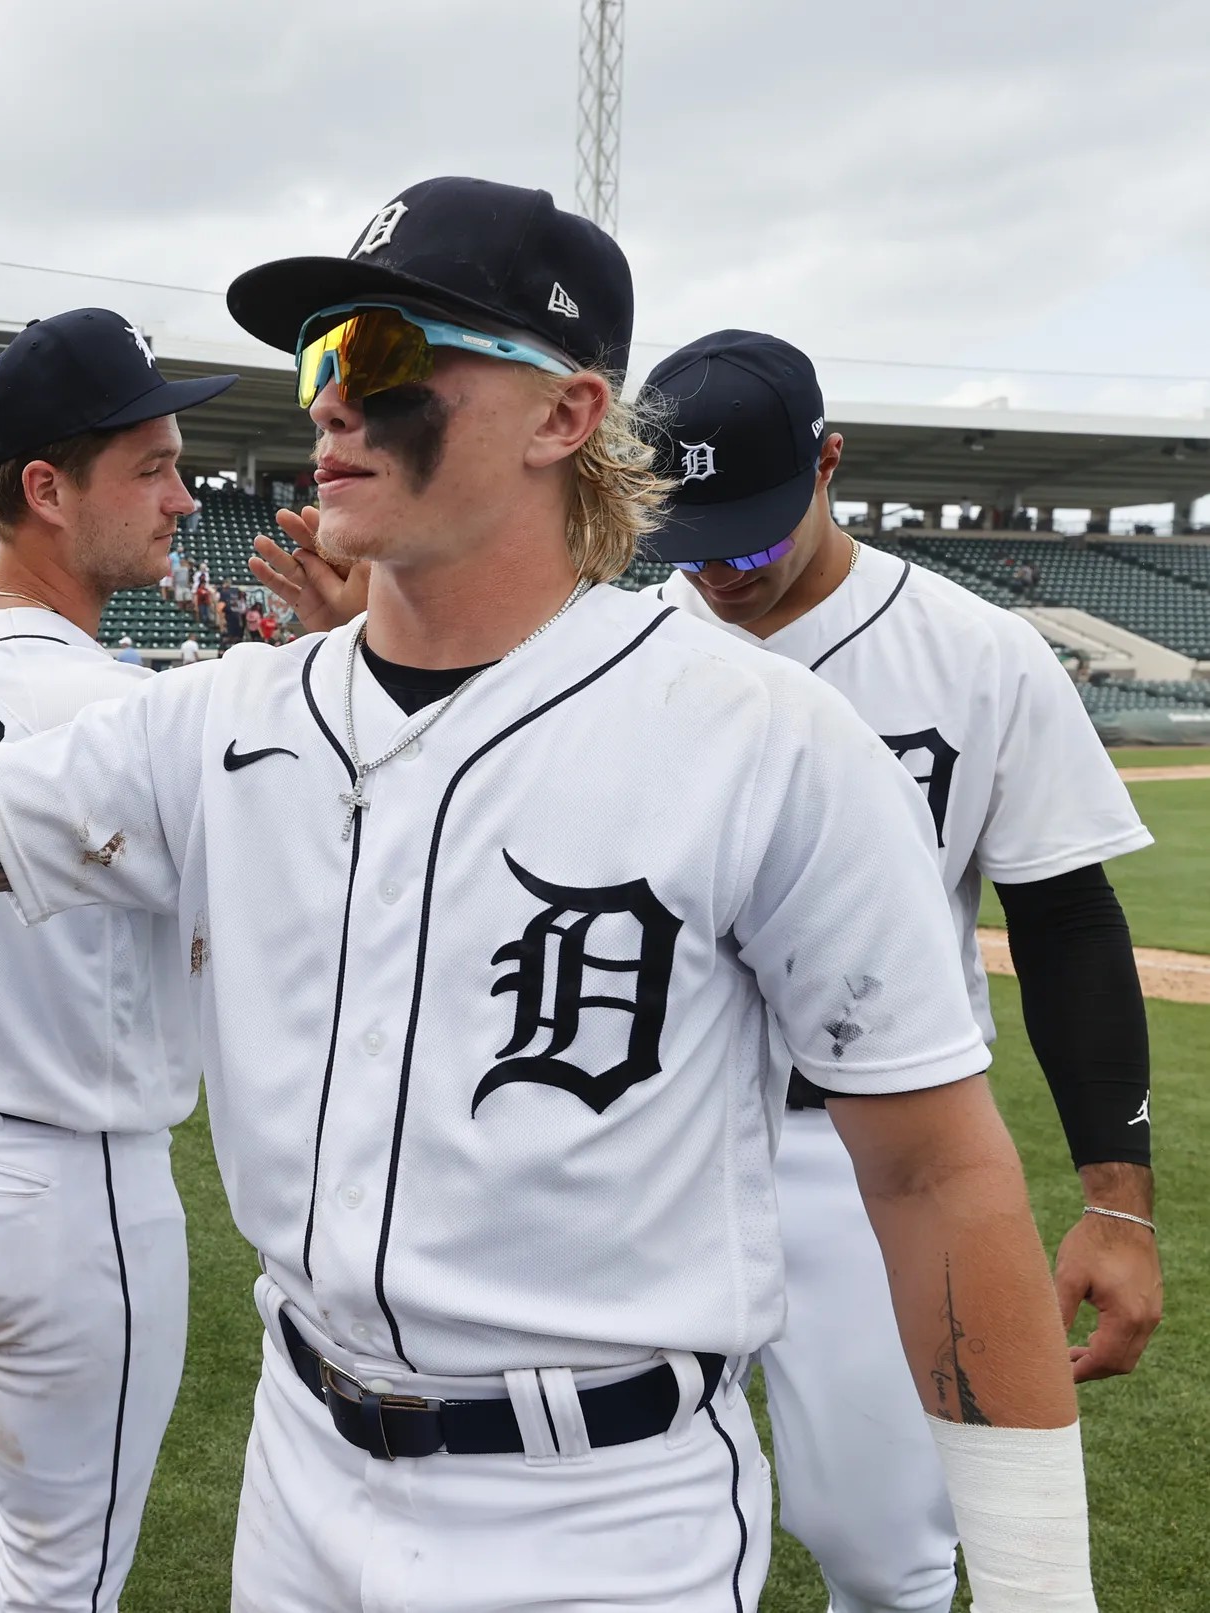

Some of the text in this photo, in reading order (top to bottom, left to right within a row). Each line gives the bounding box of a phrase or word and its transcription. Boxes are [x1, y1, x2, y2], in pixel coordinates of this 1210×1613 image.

[350, 200, 409, 260] D
[679, 440, 717, 486] D
[471, 847, 686, 1120] D
